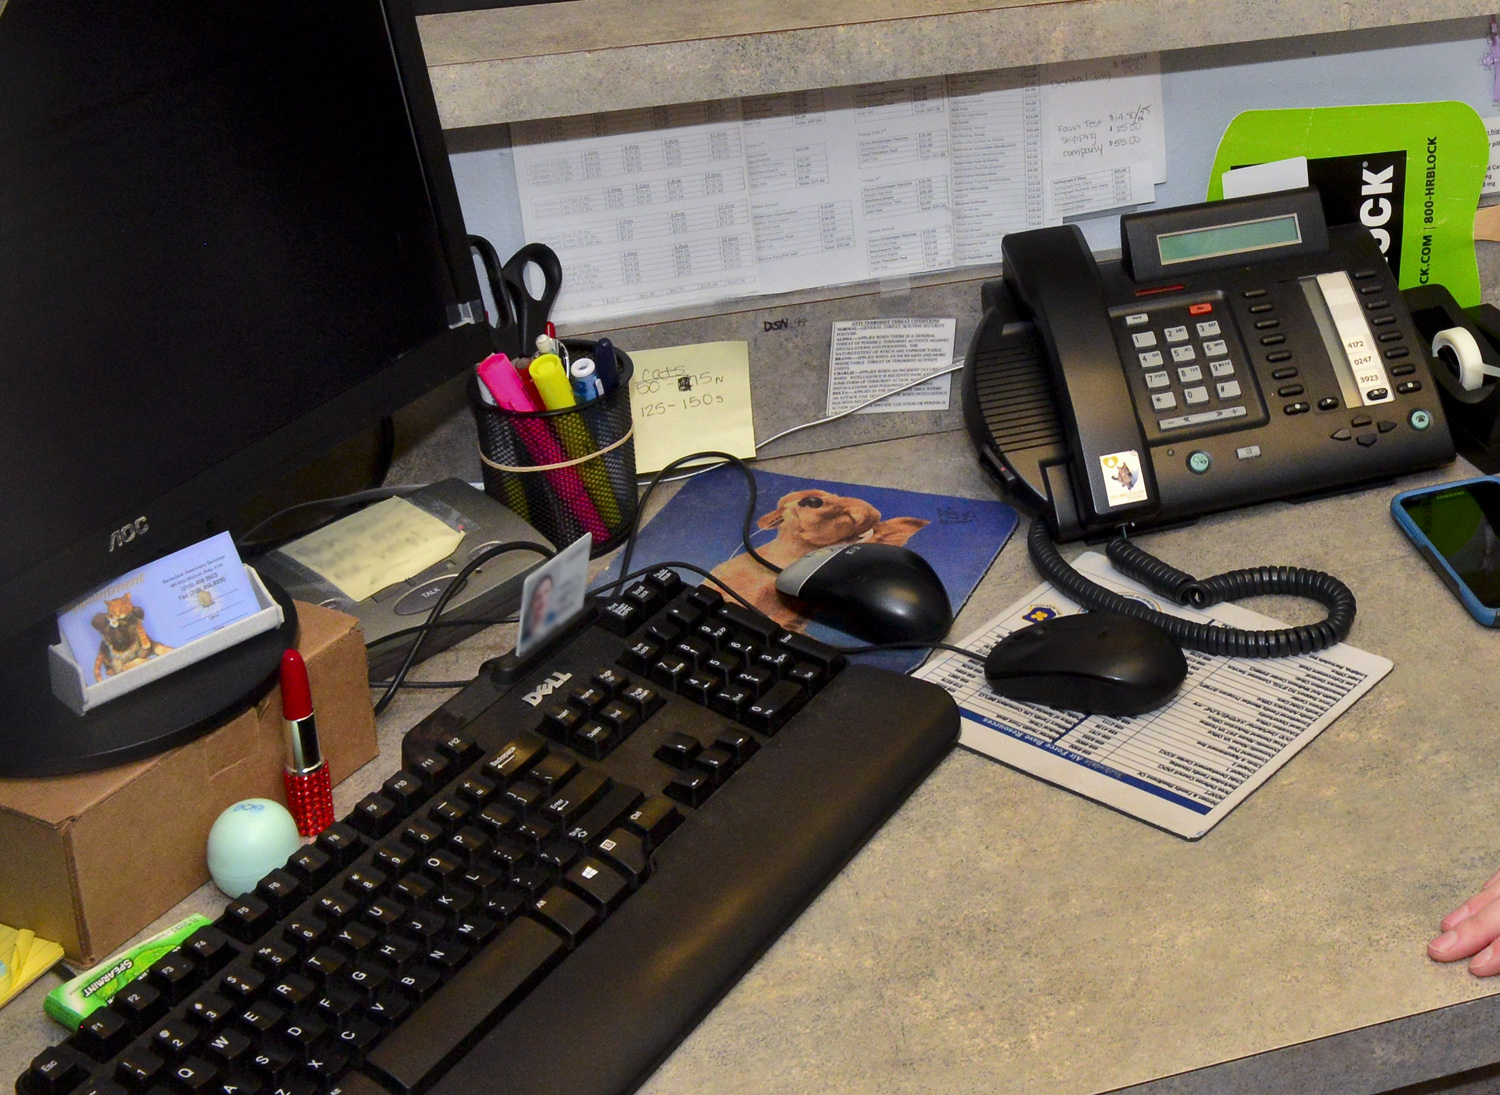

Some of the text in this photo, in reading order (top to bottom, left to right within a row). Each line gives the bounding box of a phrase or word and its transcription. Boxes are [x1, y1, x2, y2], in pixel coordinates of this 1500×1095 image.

[1424, 136, 1437, 224] 800-HRBLOCK
[1359, 164, 1394, 256] OCK
[763, 318, 788, 332] DSN
[1347, 340, 1364, 349] 4172
[1354, 356, 1372, 365] 0247
[1360, 374, 1379, 383] 3923
[109, 516, 149, 553] AOC
[421, 587, 441, 598] TALK
[522, 671, 573, 706] DELL
[983, 717, 1022, 737] Resources
[1025, 735, 1044, 746] Base
[1045, 742, 1068, 756] Force
[1069, 753, 1084, 761] Air
[368, 906, 383, 916] U
[339, 931, 352, 940] Y
[308, 957, 322, 967] T
[82, 957, 135, 998] SPEARMINT
[352, 971, 367, 981] G
[401, 976, 415, 986] B
[277, 984, 292, 995] R
[243, 1011, 259, 1022] E
[287, 1026, 302, 1036] D
[341, 1030, 356, 1040] C
[211, 1036, 230, 1049] W
[255, 1055, 269, 1065] S
[307, 1060, 323, 1069] X
[41, 1060, 57, 1072] Esc
[177, 1068, 195, 1079] Q
